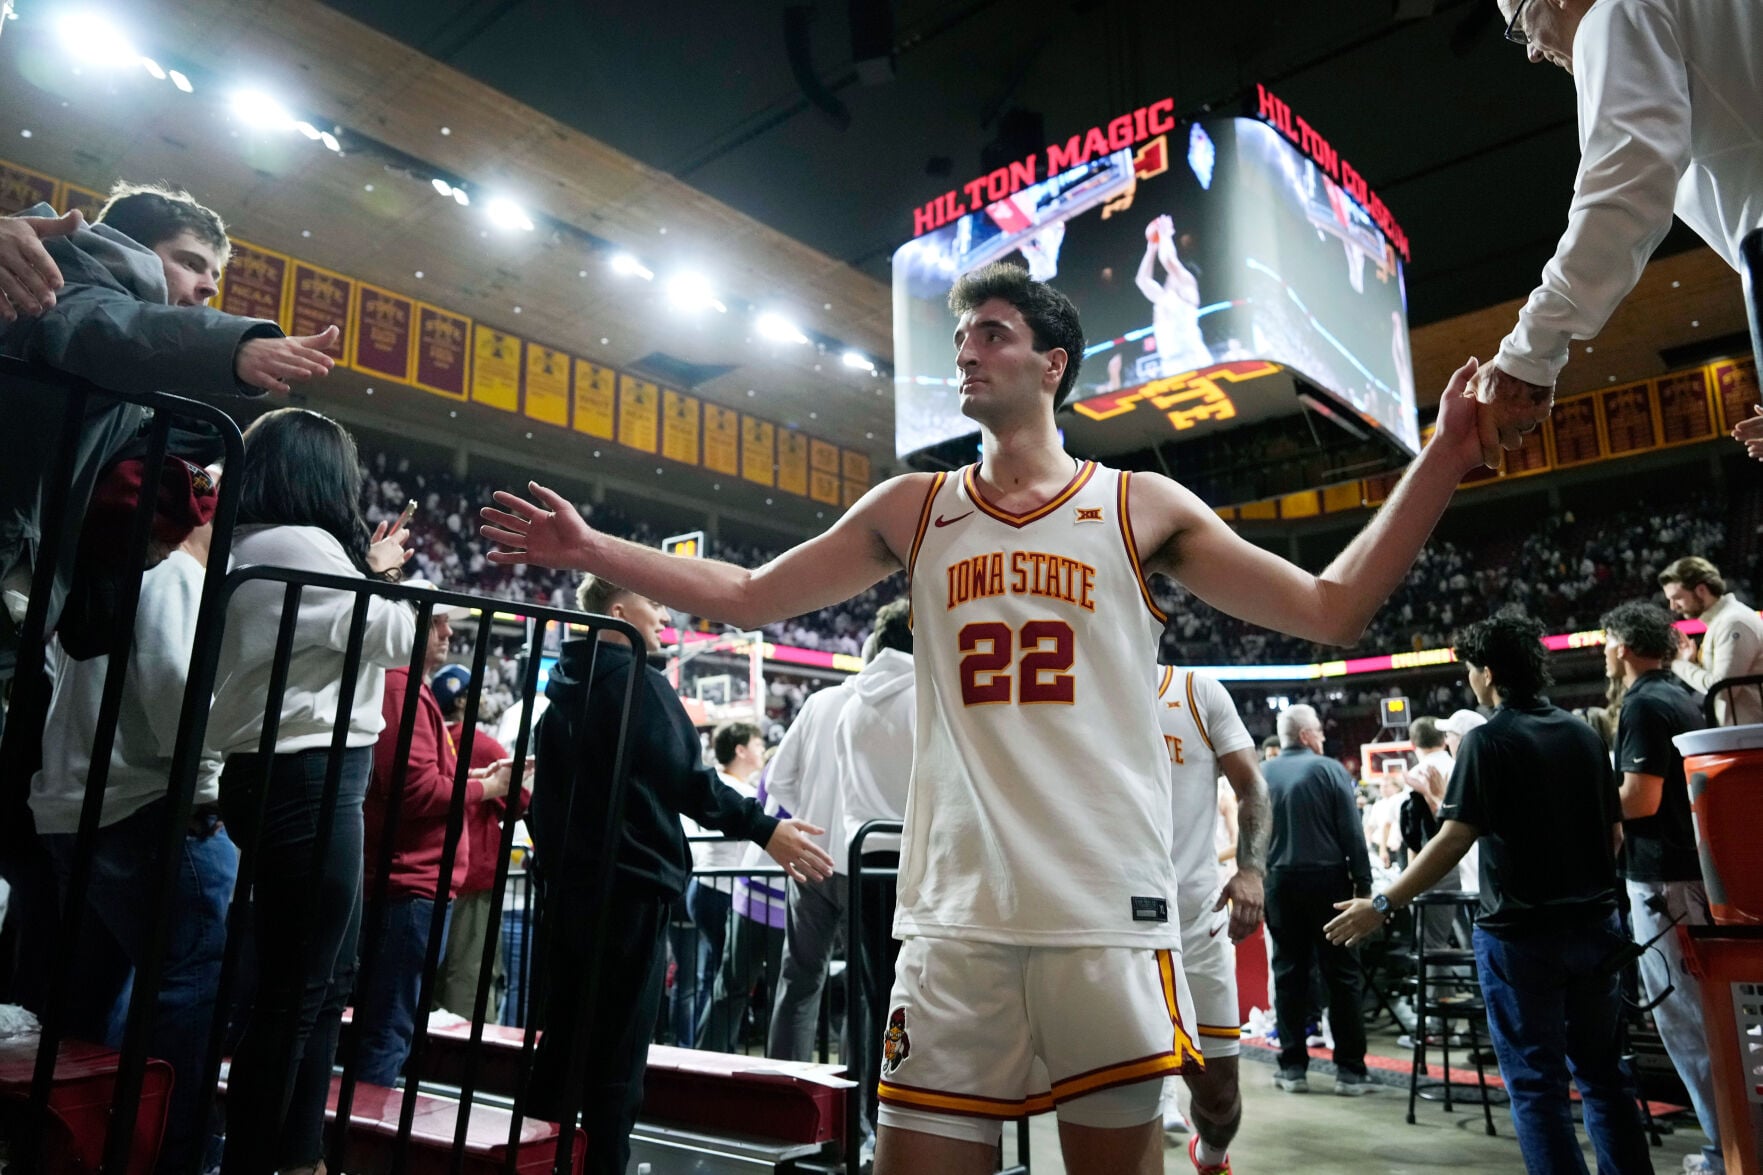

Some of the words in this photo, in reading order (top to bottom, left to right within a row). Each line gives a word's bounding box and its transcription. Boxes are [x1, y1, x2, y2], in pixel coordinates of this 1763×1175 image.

[912, 154, 1037, 237] HILTON
[1046, 97, 1175, 178] MAGIC
[1256, 82, 1339, 179] HILTON
[1341, 159, 1412, 264] COLISEUM
[946, 551, 1006, 613] IOWA
[1011, 550, 1096, 613] STATE
[958, 620, 1075, 706] 22
